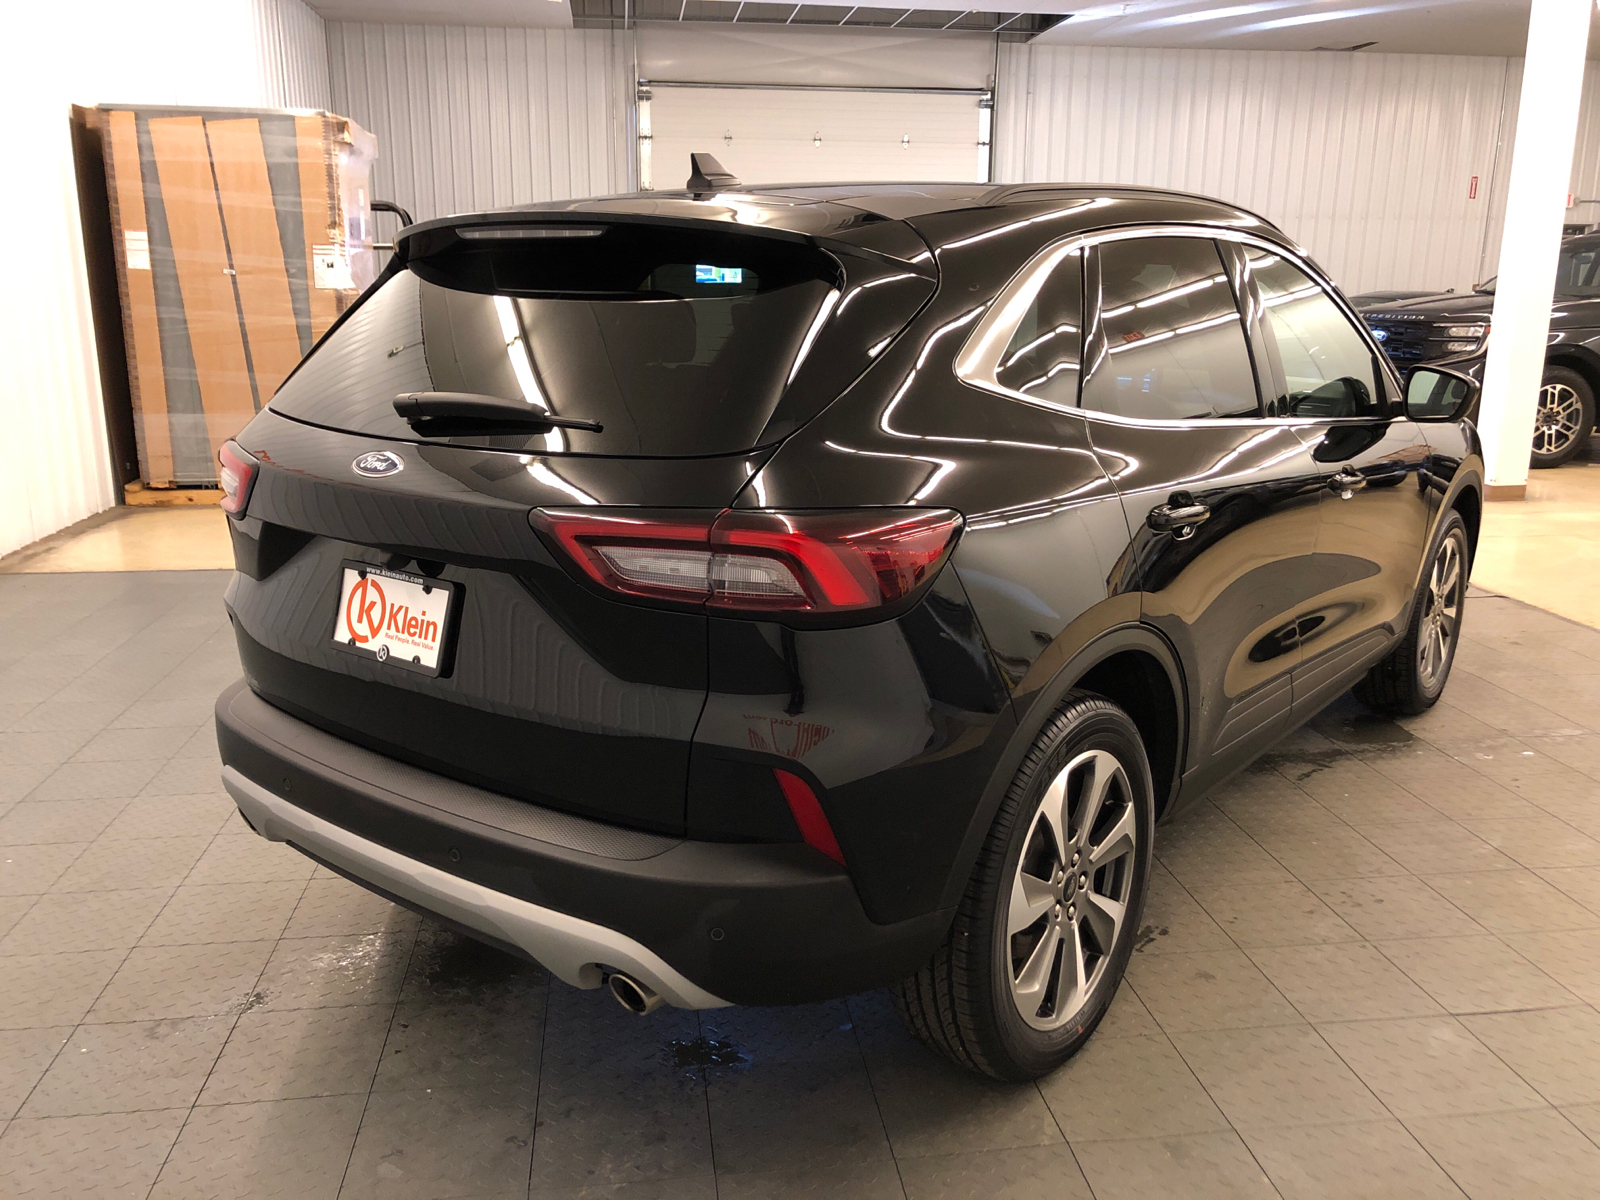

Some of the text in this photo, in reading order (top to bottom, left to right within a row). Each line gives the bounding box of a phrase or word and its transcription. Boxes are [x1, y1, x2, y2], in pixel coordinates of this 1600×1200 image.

[359, 454, 392, 471] Ford
[366, 566, 424, 585] www.kleinauto.com
[386, 602, 438, 643] Klein
